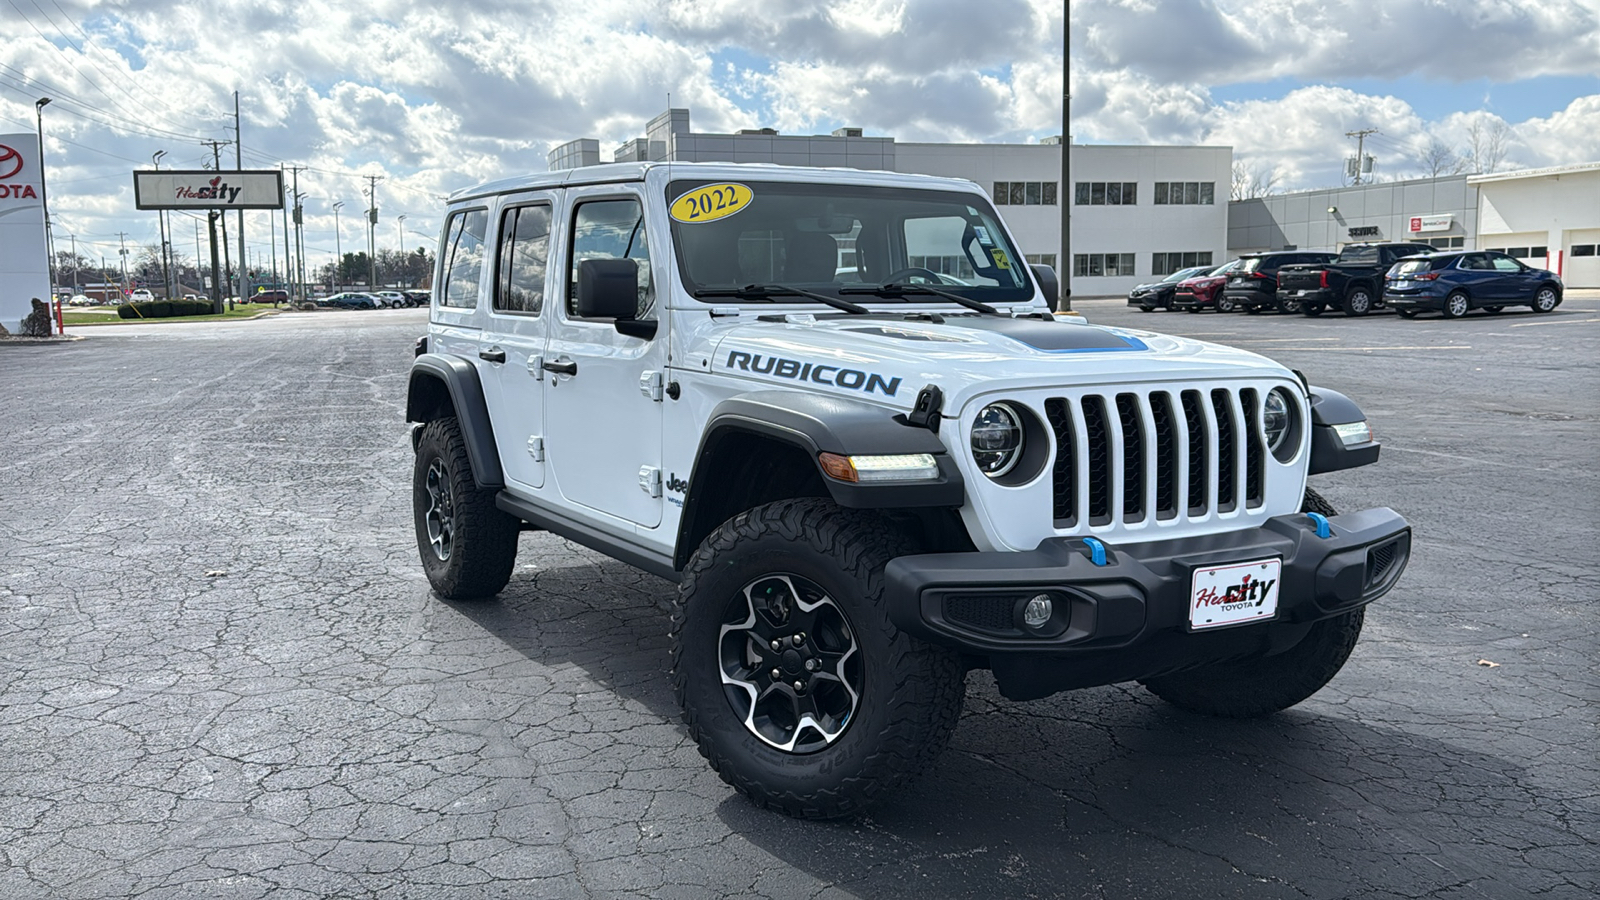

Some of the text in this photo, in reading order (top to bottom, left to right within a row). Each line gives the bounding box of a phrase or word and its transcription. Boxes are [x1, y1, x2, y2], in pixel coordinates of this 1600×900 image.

[686, 186, 739, 219] 2022
[726, 350, 903, 397] RUBICON
[666, 472, 688, 495] Jee
[1195, 586, 1250, 609] Heart
[1221, 602, 1253, 612] TOYOTA
